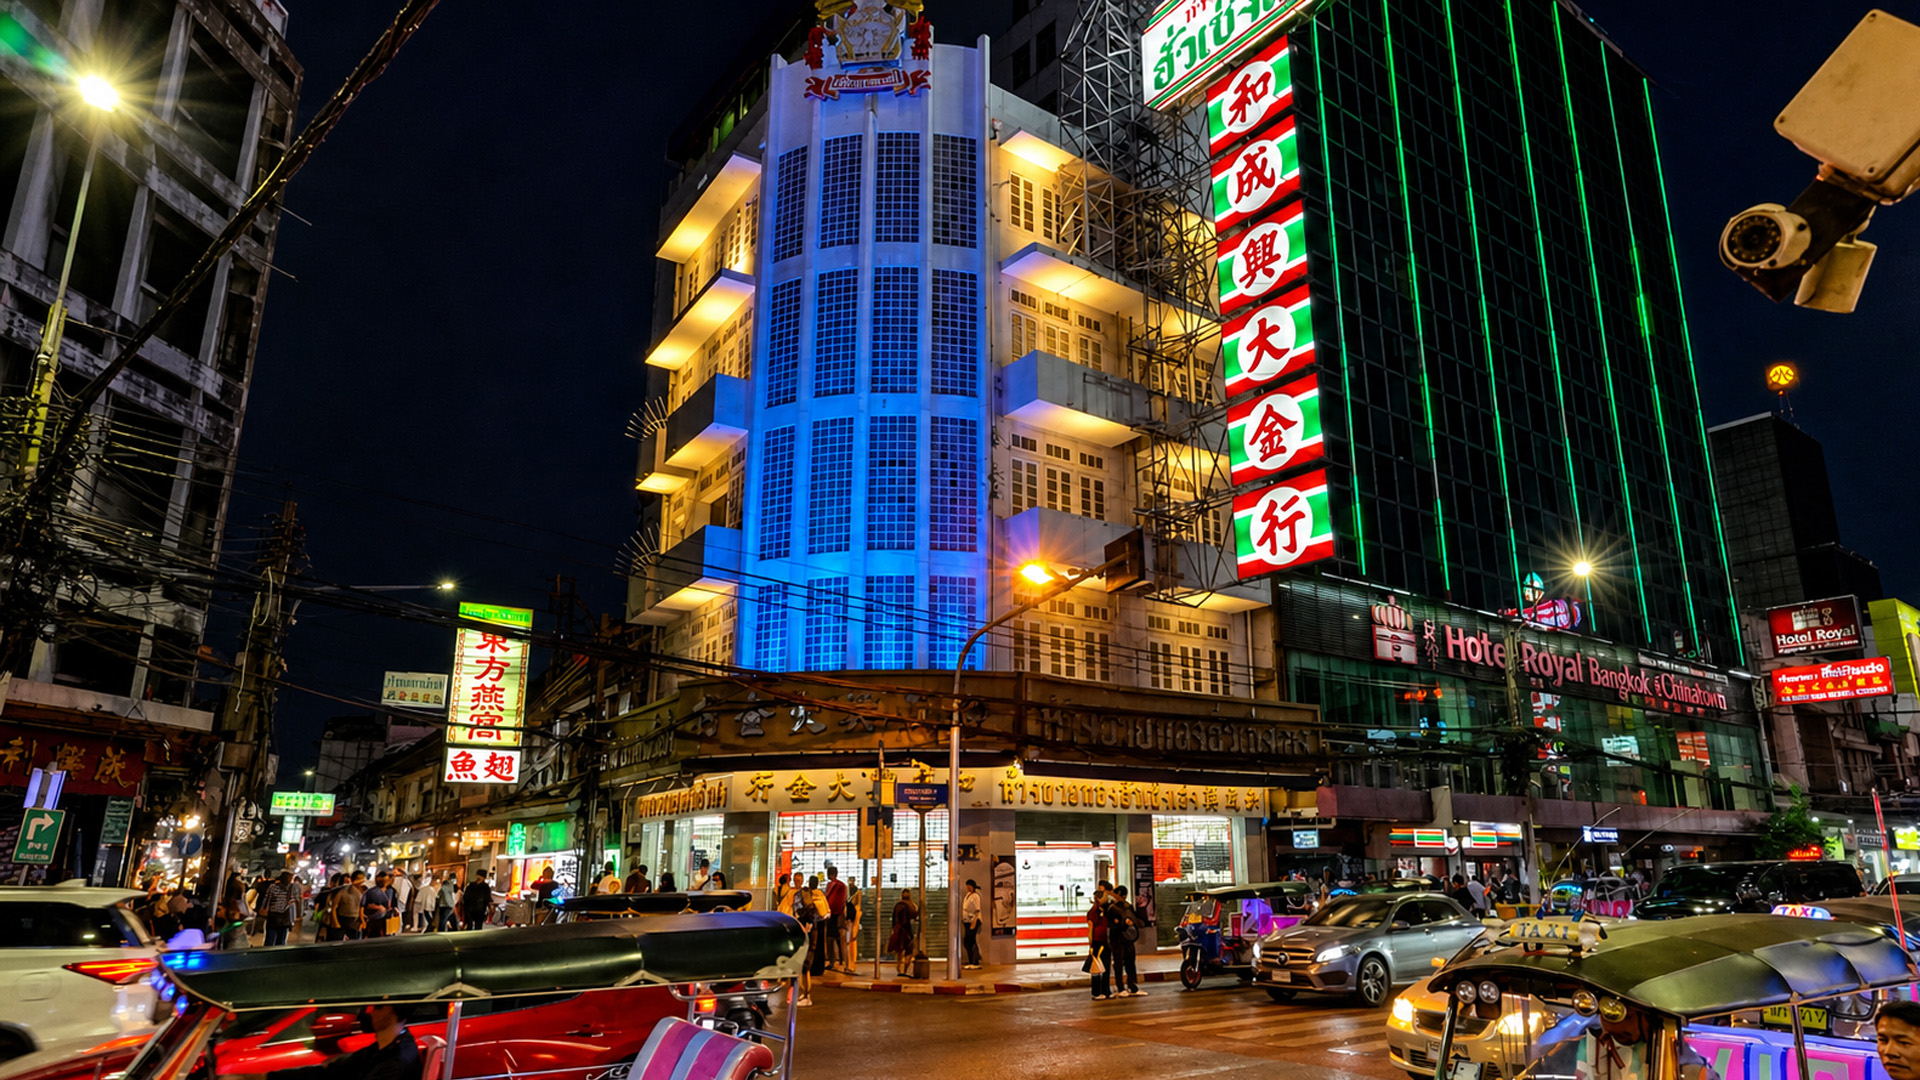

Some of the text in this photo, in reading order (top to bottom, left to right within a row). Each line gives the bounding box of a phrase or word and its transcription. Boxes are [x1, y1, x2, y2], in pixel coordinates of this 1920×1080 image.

[1228, 71, 1305, 556] 和成興大金行
[1816, 624, 1856, 642] Royal
[1444, 624, 1508, 670] Hote
[1521, 641, 1583, 687] Royal
[1588, 656, 1652, 702] Bangkok
[447, 751, 515, 781] 魚翅
[1778, 906, 1817, 918] TAXI
[1521, 923, 1569, 940] TAXI
